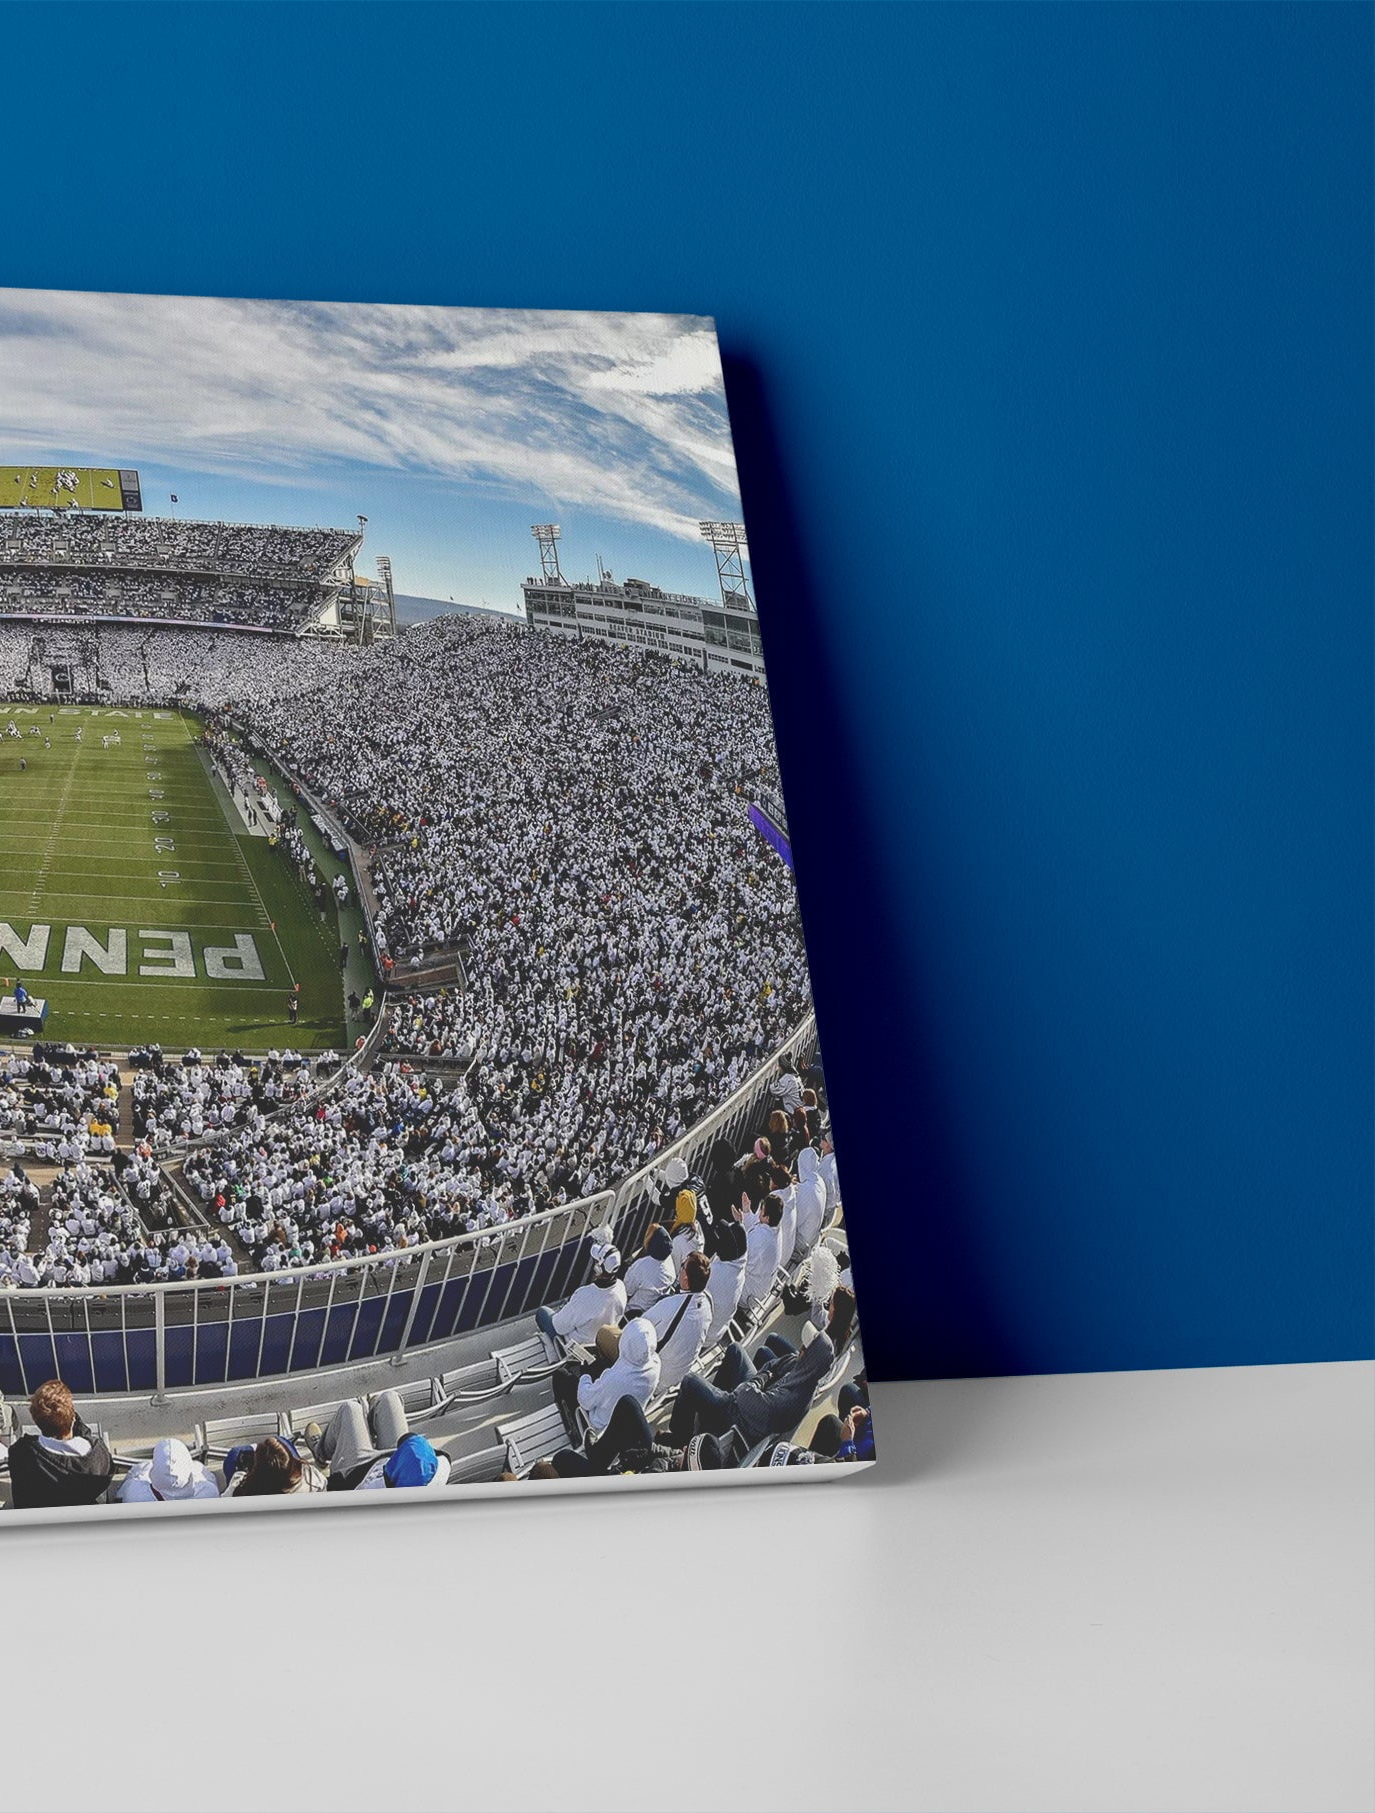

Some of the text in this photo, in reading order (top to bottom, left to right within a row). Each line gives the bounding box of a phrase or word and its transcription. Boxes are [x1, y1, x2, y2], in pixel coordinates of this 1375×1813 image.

[57, 708, 175, 720] STATE
[153, 837, 176, 852] 20
[157, 870, 182, 884] 10
